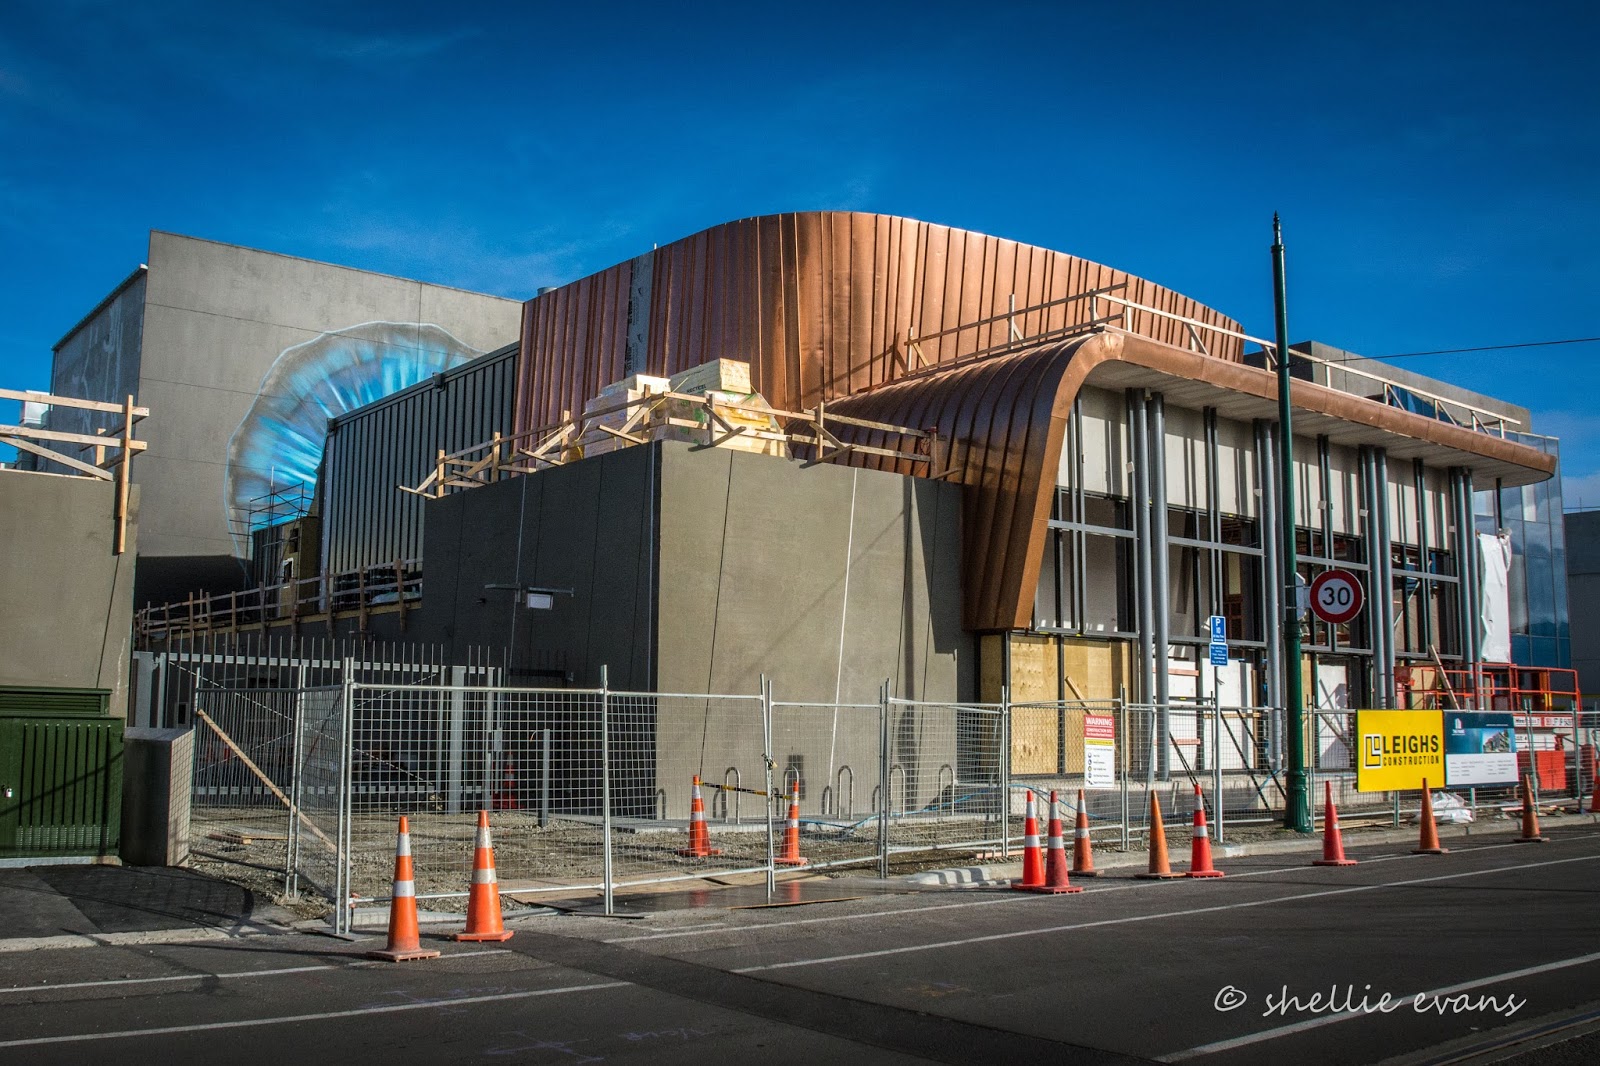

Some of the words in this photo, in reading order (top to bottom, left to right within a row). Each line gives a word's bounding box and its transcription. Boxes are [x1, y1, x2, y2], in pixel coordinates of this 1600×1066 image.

[1322, 587, 1351, 606] 30
[1215, 618, 1221, 627] P
[1085, 716, 1113, 727] WARNING
[1382, 735, 1439, 754] LEIGHS
[1383, 755, 1440, 767] CONSTRUCTION
